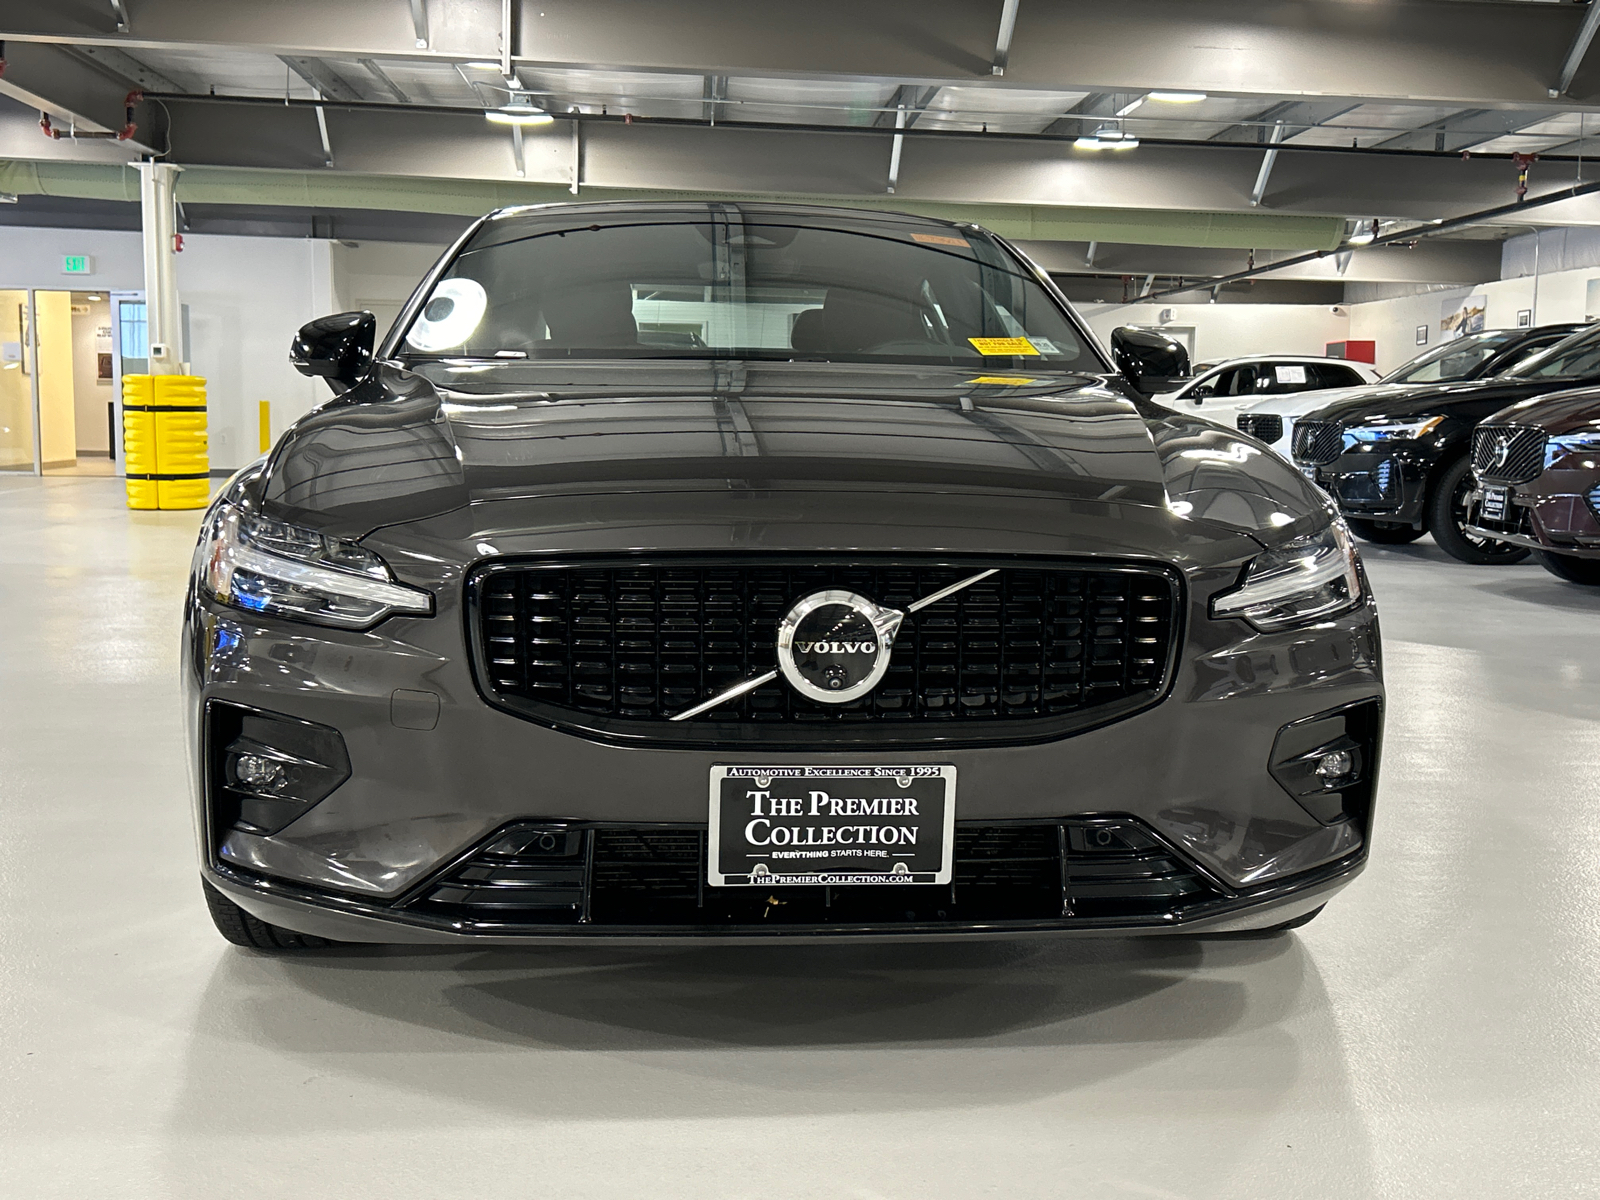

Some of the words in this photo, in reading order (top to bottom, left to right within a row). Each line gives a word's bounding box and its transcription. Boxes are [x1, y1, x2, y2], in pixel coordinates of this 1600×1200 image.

[66, 256, 85, 271] EXIT
[794, 641, 876, 654] VOLVO
[729, 767, 801, 776] AUTOMOTIVE
[804, 767, 871, 776] EXCELLENCE
[873, 767, 906, 776] SINCE
[909, 767, 939, 776] 1995
[746, 790, 803, 816] THE
[808, 790, 919, 816] PREMIER
[744, 818, 919, 846] COLLECTION
[772, 851, 829, 859] EVERYTHING
